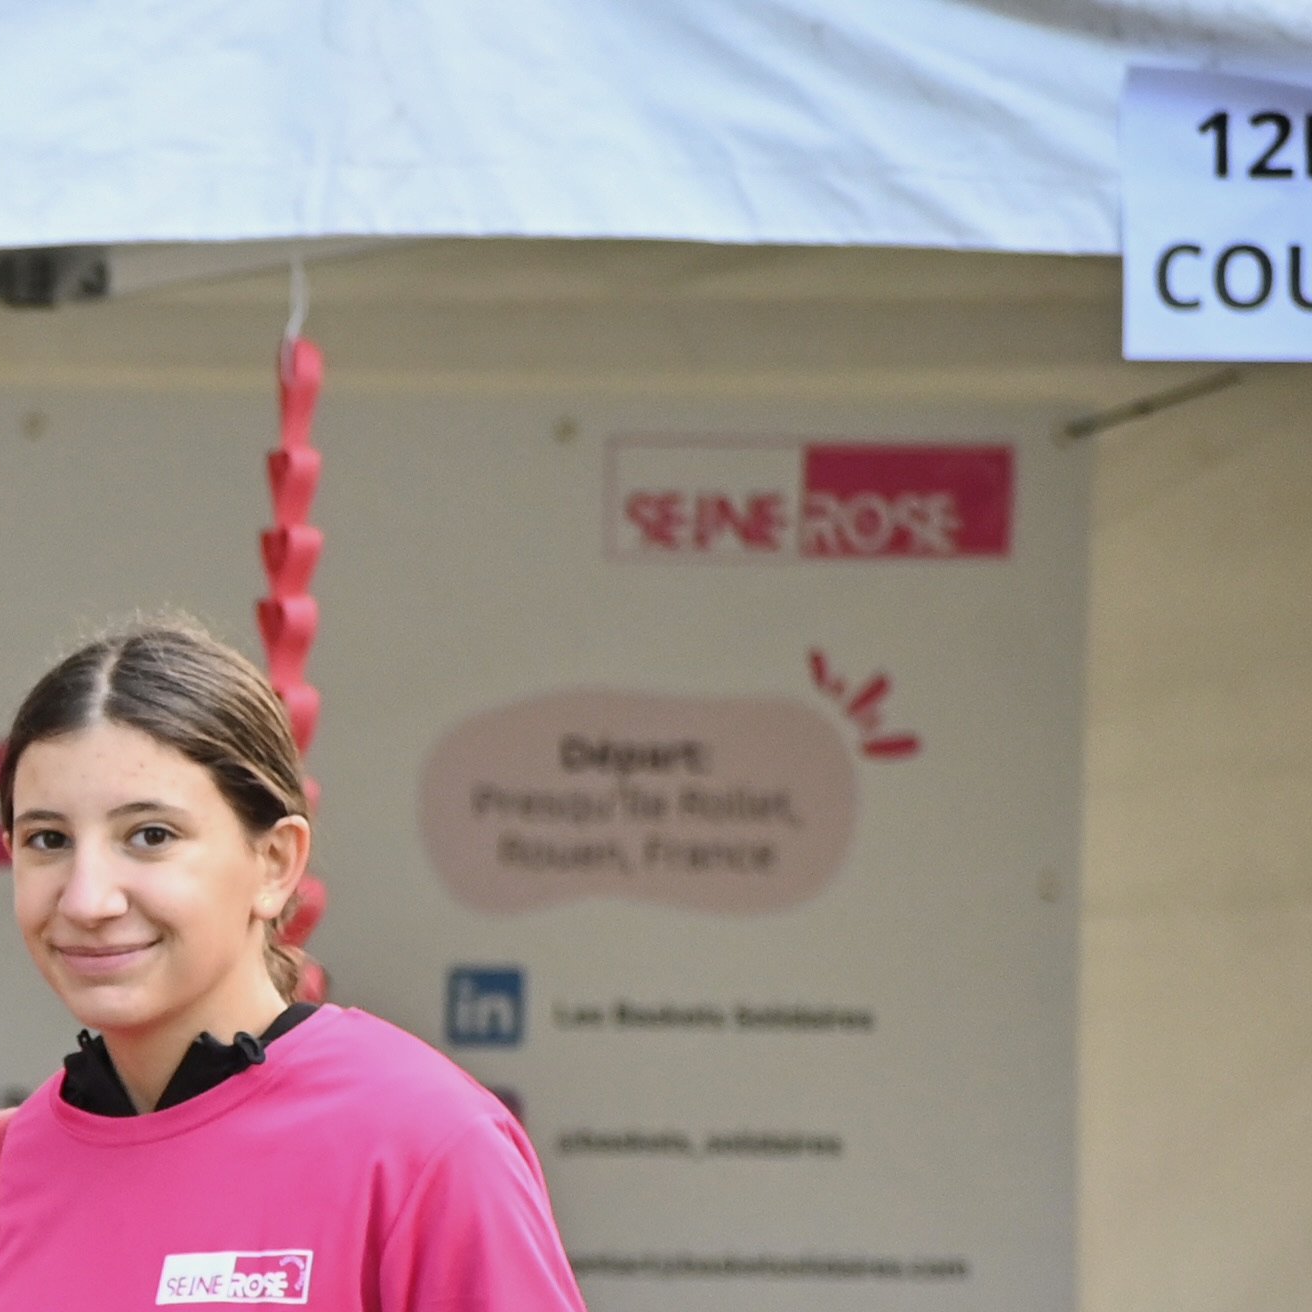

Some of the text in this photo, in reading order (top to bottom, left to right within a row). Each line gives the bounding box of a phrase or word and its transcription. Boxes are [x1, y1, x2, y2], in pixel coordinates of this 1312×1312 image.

[1198, 110, 1312, 179] 12
[166, 1273, 224, 1297] SEINE
[227, 1271, 289, 1298] ROSE
